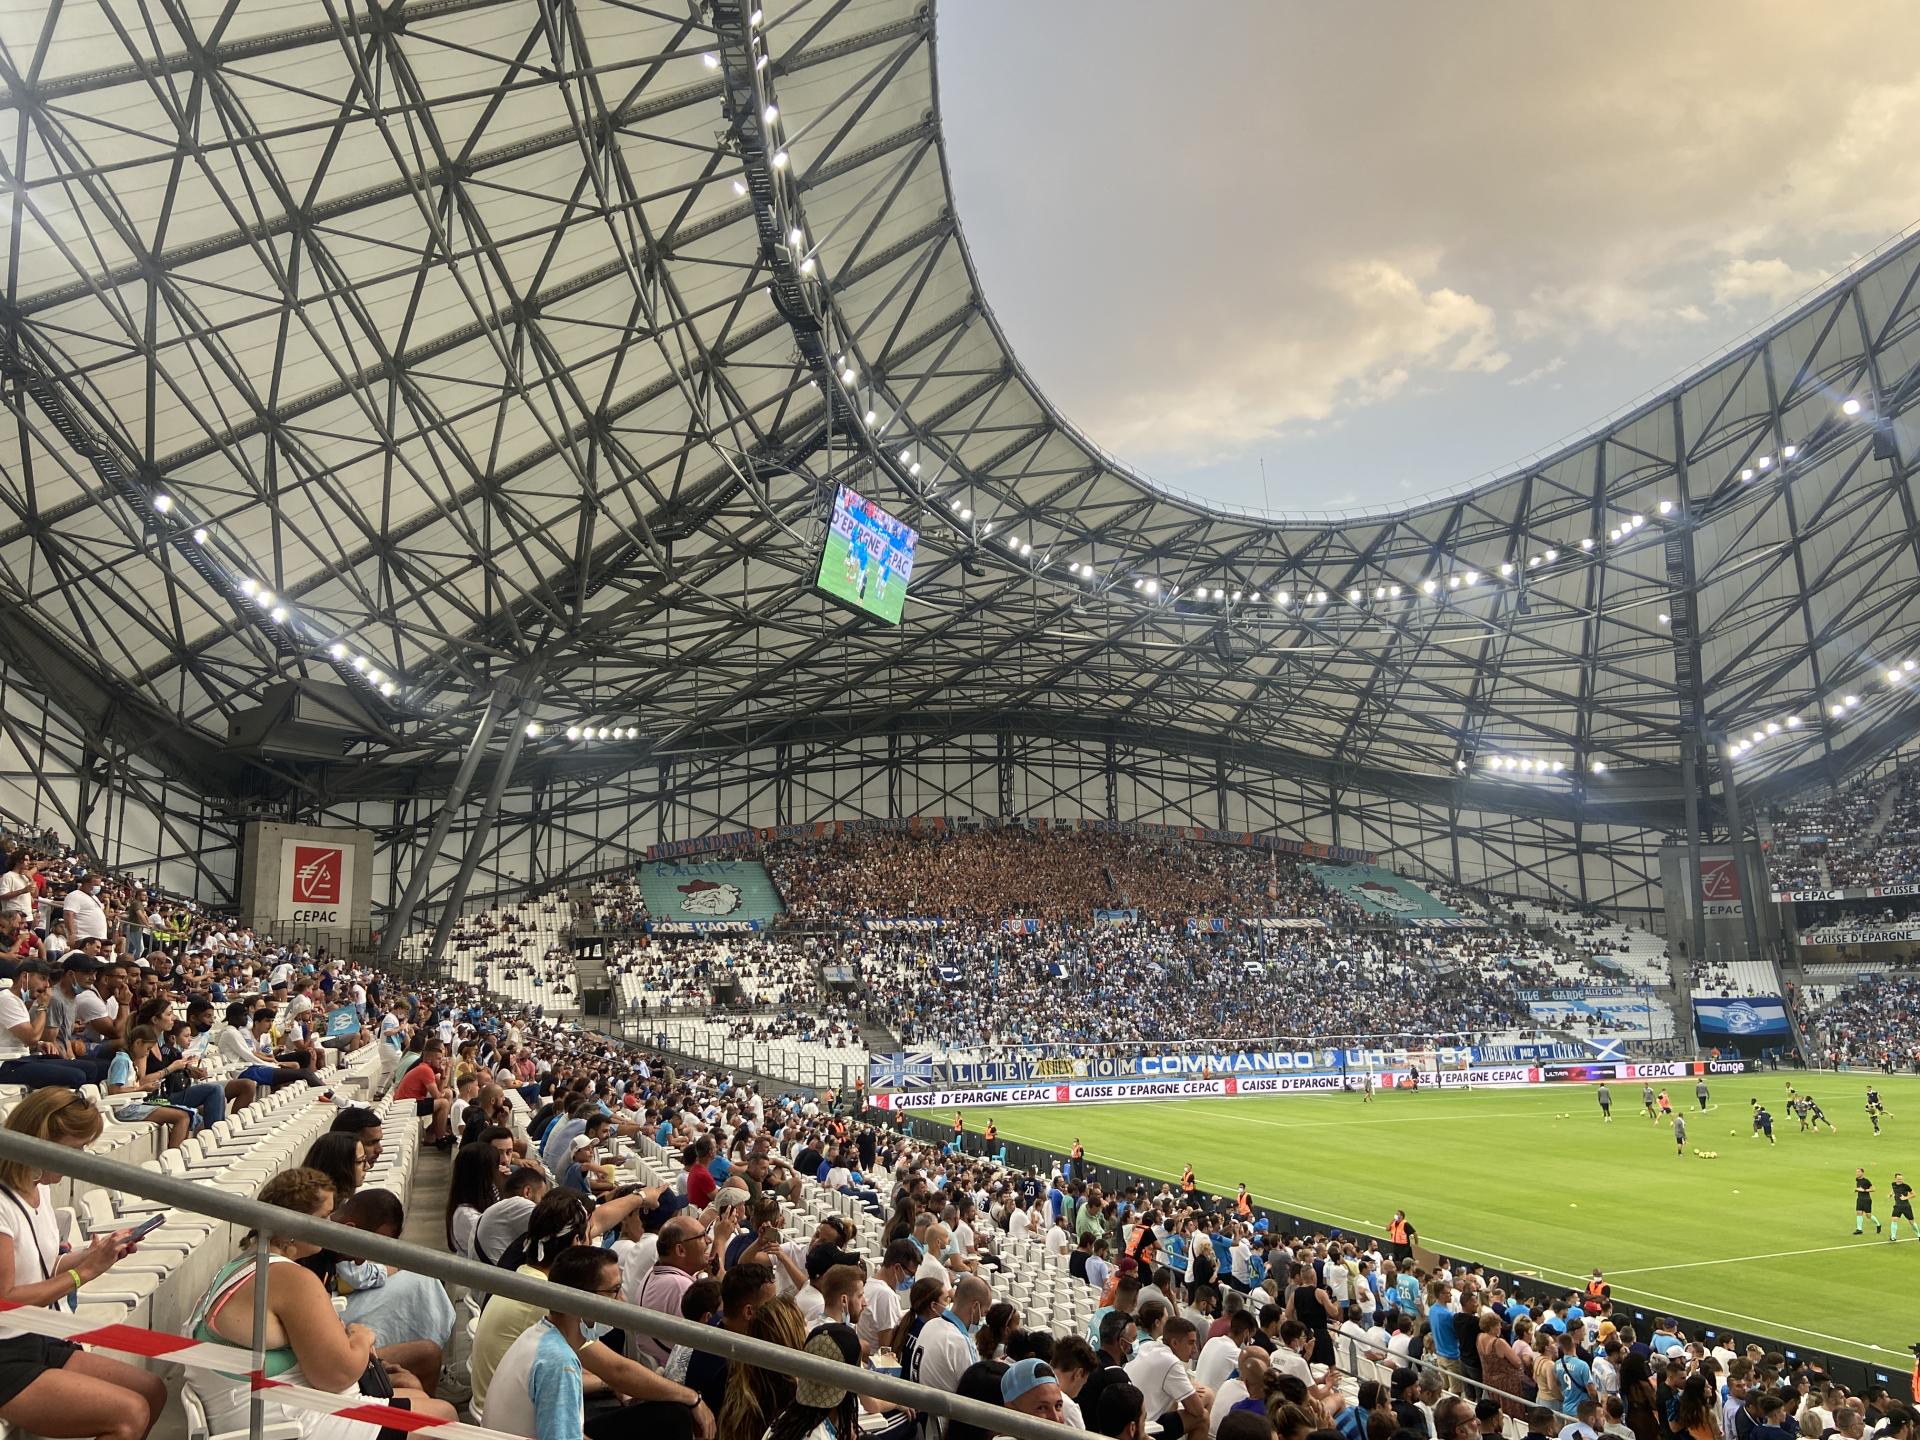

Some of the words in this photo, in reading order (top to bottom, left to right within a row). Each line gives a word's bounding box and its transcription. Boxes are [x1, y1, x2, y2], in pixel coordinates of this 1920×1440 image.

[832, 509, 881, 556] D'EPRGNE
[885, 547, 909, 575] EPAC
[1793, 890, 1835, 901] CEPAC
[1882, 885, 1914, 895] CAISSE
[293, 909, 337, 923] CEPAC
[650, 922, 695, 933] ZONE
[695, 921, 754, 932] KAOTIC
[1815, 933, 1848, 944] CAISSE
[1851, 931, 1912, 943] D'EPARGNE
[1479, 1045, 1516, 1062] LIBERTE
[1520, 1047, 1534, 1059] pour
[1539, 1045, 1549, 1056] les
[1552, 1043, 1584, 1059] ULTRAS
[883, 1064, 925, 1075] MARSEILLE
[1141, 1051, 1314, 1074] COMMANDO
[1709, 1061, 1744, 1074] Orange
[1638, 1063, 1675, 1077] CEPAC
[1242, 1080, 1277, 1091] CAISSE
[1282, 1077, 1340, 1089] D'EPARGNE
[1398, 1074, 1431, 1086] CASSE
[1435, 1072, 1489, 1083] D'EPARGNE
[1492, 1070, 1523, 1081] CEPAC
[1075, 1086, 1113, 1098] CAISSE
[1118, 1083, 1180, 1096] D'EPARGNE
[1183, 1081, 1219, 1093] CEPAC
[895, 1094, 936, 1107] CAISSE
[941, 1090, 1007, 1105] D'EPARGNE
[1012, 1088, 1050, 1101] CEPAC
[1024, 1185, 1035, 1197] 20
[1399, 1287, 1411, 1300] 26
[1563, 1373, 1572, 1391] 9
